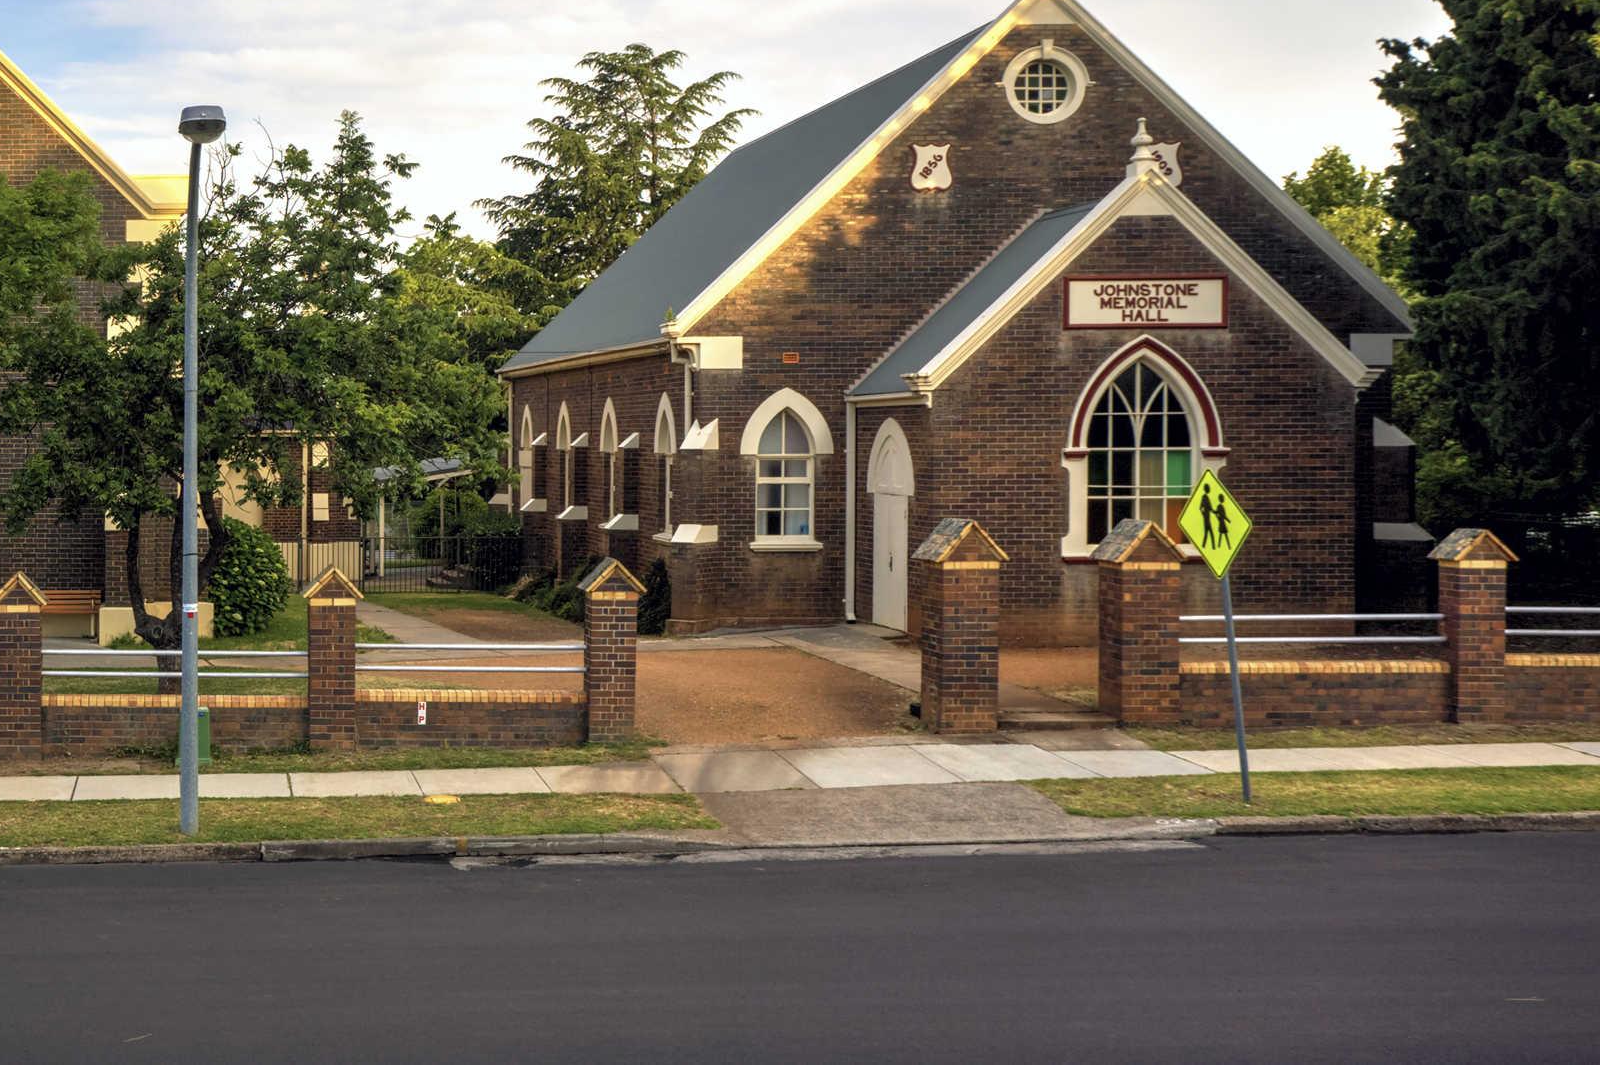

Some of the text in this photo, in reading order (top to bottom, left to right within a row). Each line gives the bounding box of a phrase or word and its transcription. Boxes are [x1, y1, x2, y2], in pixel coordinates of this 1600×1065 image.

[919, 154, 943, 179] 1856
[1094, 284, 1198, 296] JOHNSTONE
[1100, 297, 1188, 309] MEMORIAL
[1122, 310, 1168, 322] HALL
